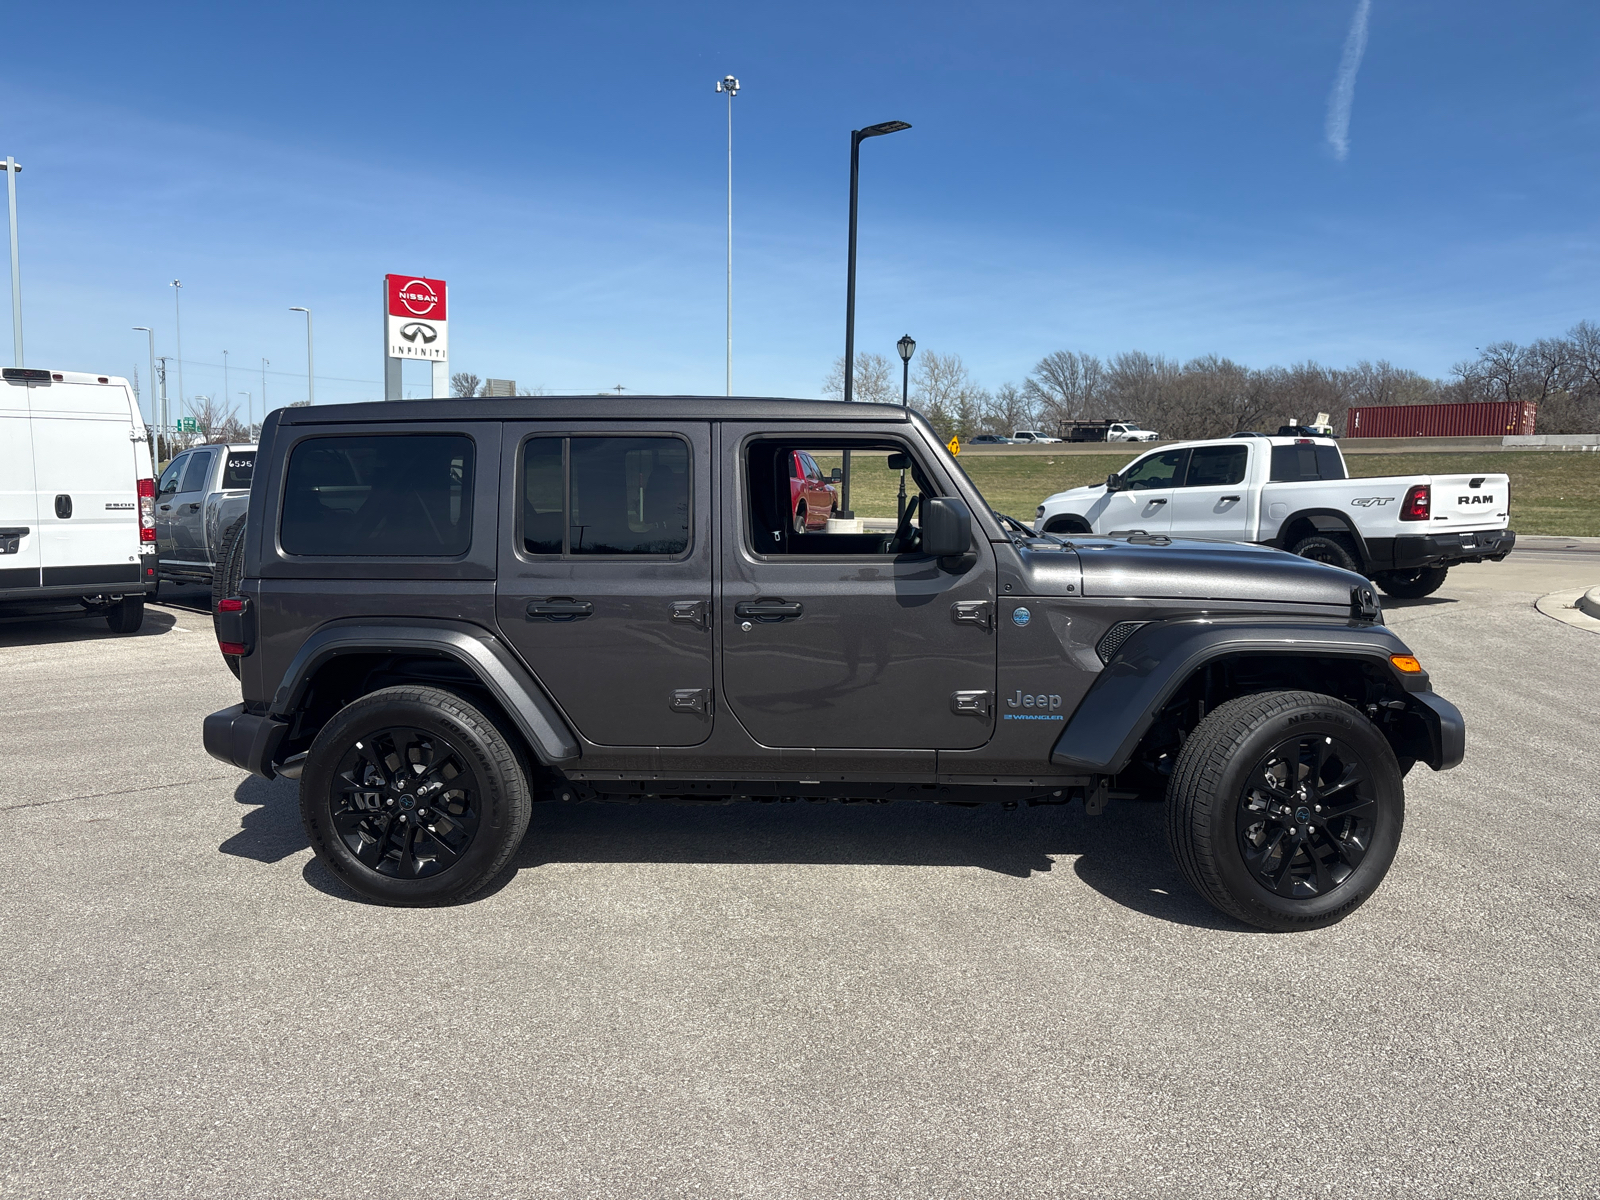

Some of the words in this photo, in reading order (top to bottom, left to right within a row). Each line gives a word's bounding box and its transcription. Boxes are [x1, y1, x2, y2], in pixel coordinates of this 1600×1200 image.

[399, 292, 438, 302] NISSAN
[392, 345, 445, 358] INFINITI
[1457, 495, 1493, 505] RAM
[1007, 690, 1062, 712] Jeep
[1287, 712, 1345, 725] NEXEN
[439, 718, 493, 772] ROADIAN
[1296, 894, 1360, 923] ROADIAN
